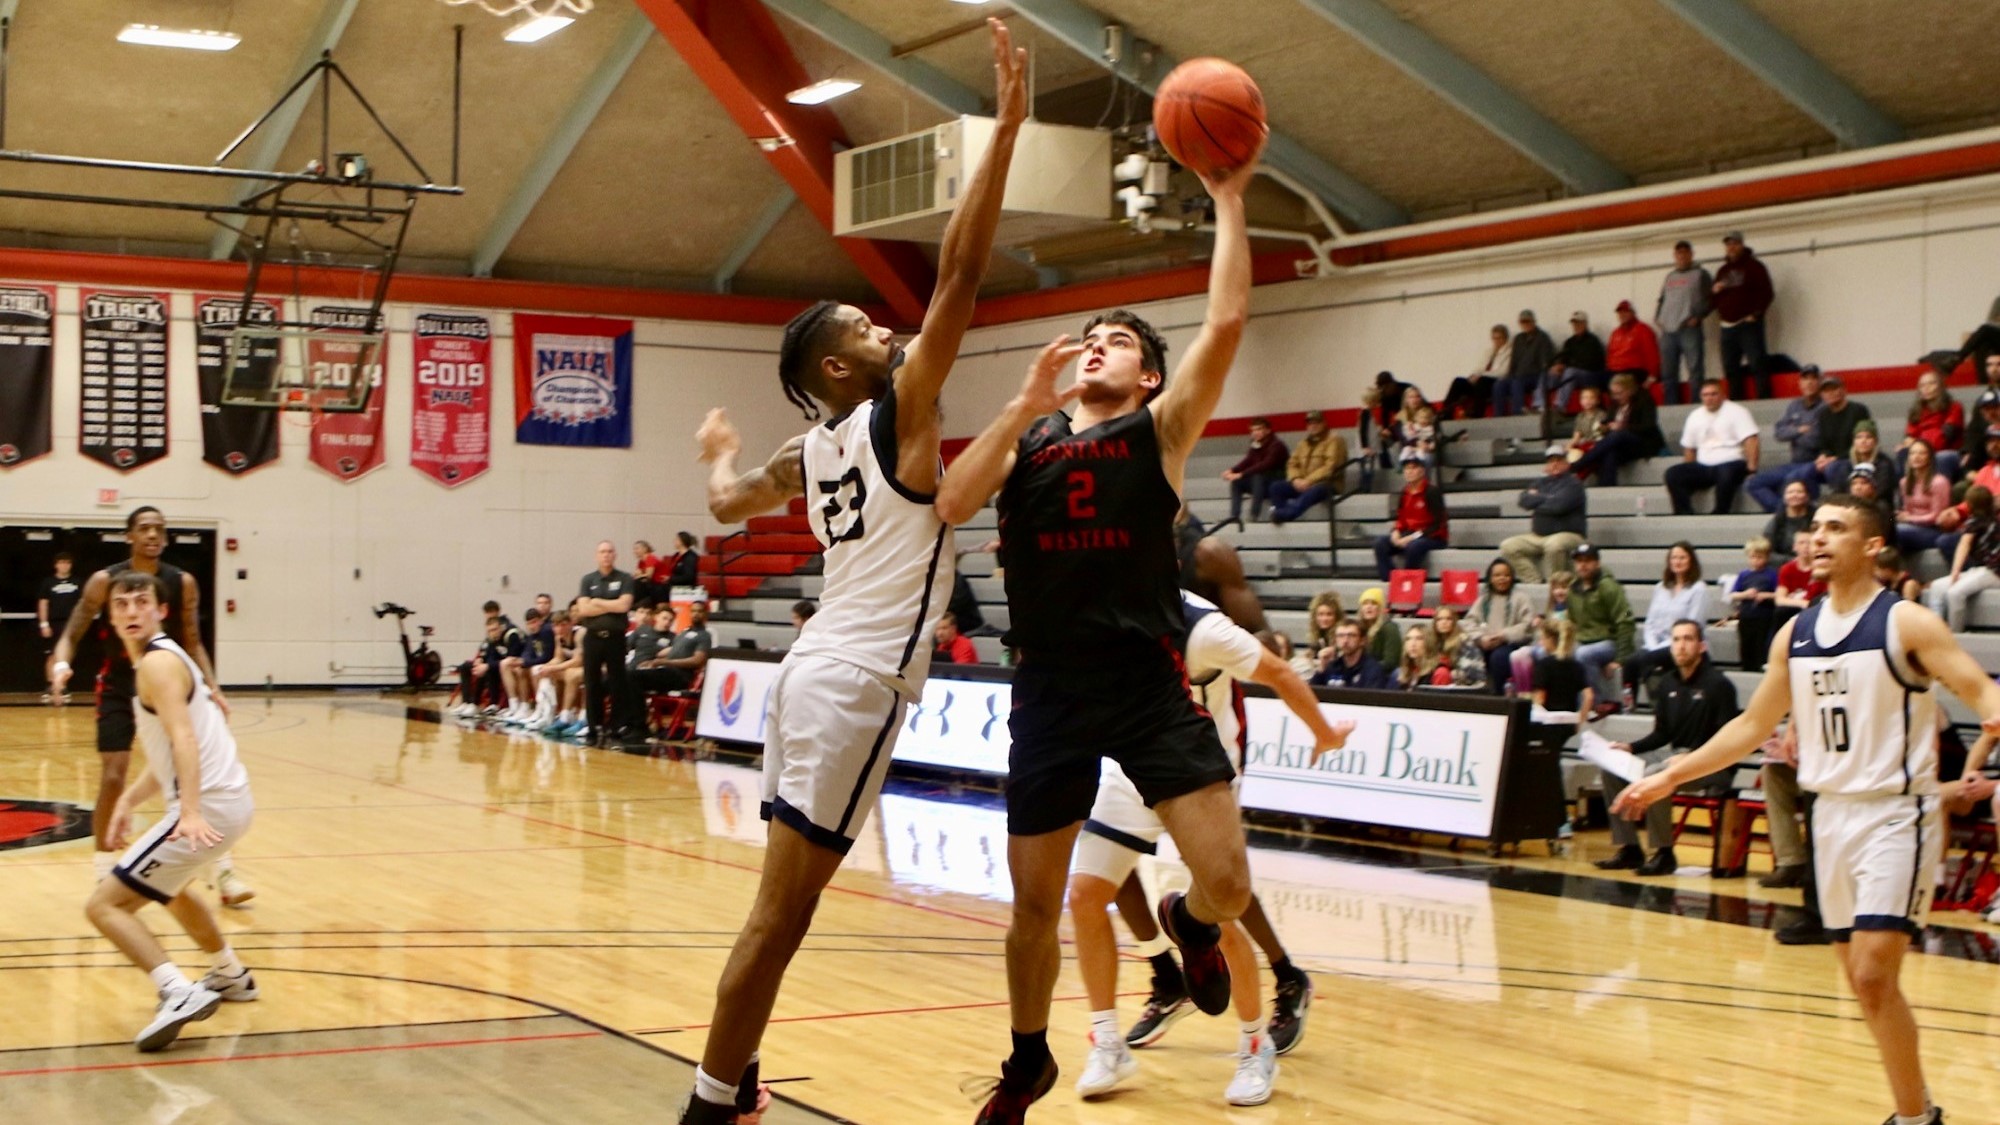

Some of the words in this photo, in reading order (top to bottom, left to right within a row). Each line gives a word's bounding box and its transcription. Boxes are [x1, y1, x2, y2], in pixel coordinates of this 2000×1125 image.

[87, 299, 163, 322] TRACK
[313, 311, 384, 329] BULLDOS
[418, 319, 489, 338] BULLDOGS
[418, 360, 485, 387] 2019
[536, 349, 610, 381] NAIA
[431, 390, 473, 406] NAIA
[542, 395, 554, 403] of
[546, 384, 599, 396] Champions
[1067, 469, 1097, 520] 2
[1038, 528, 1131, 551] WESTERN
[1820, 706, 1850, 752] 10
[1379, 722, 1481, 787] Bank
